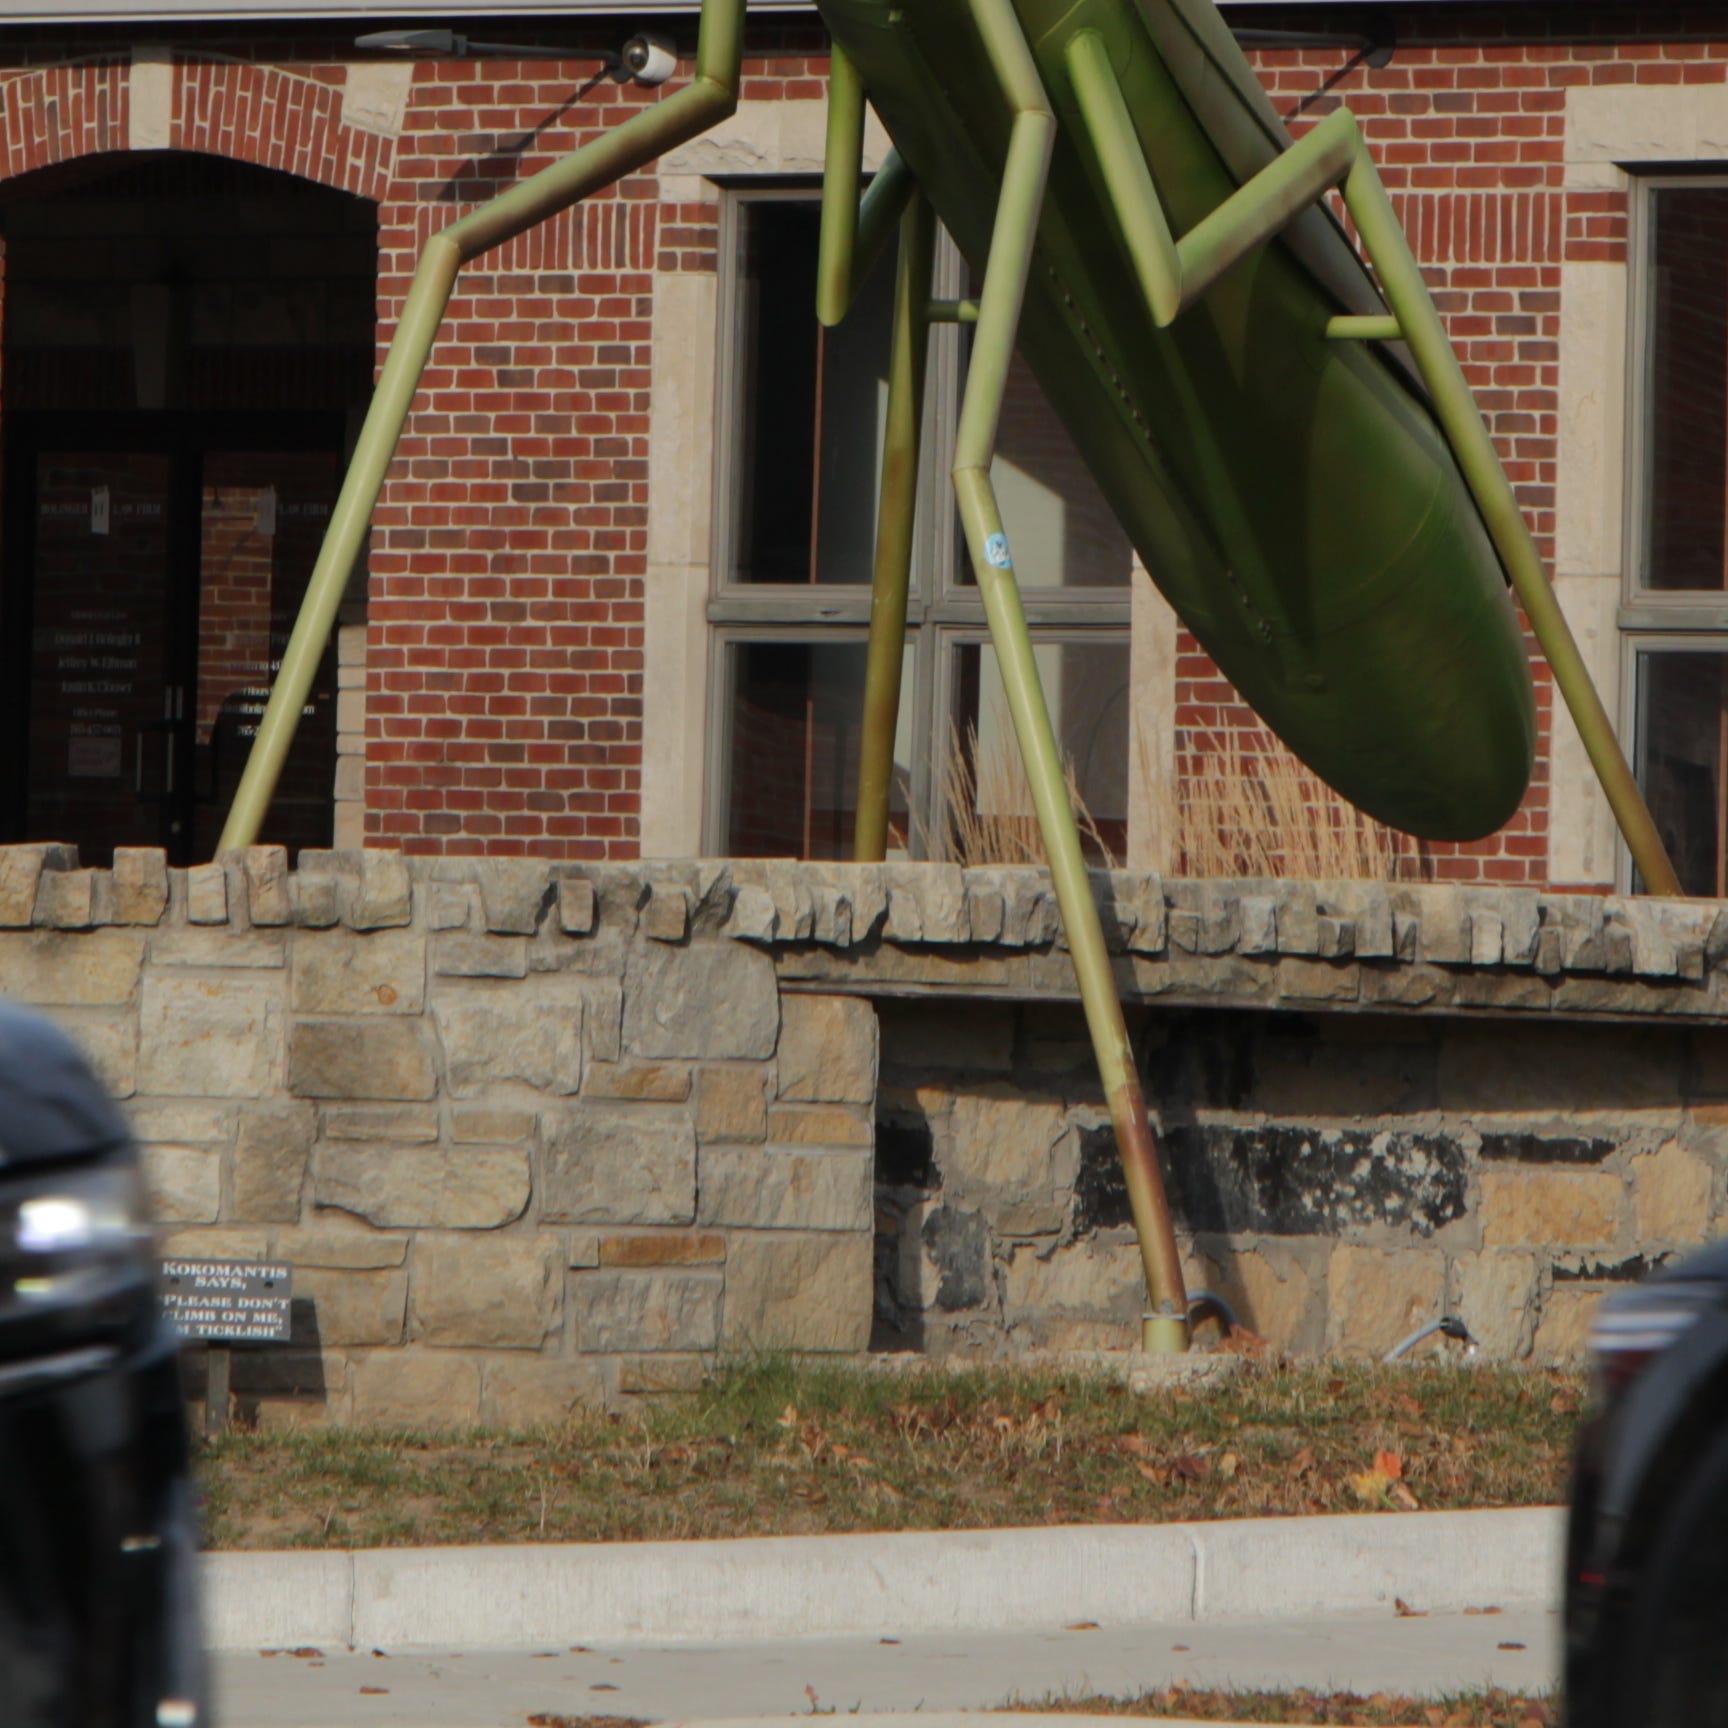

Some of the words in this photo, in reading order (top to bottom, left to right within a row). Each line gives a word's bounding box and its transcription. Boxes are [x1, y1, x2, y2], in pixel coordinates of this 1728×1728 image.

[162, 1262, 288, 1279] KOKOMANTIS
[238, 1296, 290, 1310] DON'T
[221, 1311, 246, 1322] ON
[252, 1312, 283, 1325] ME,
